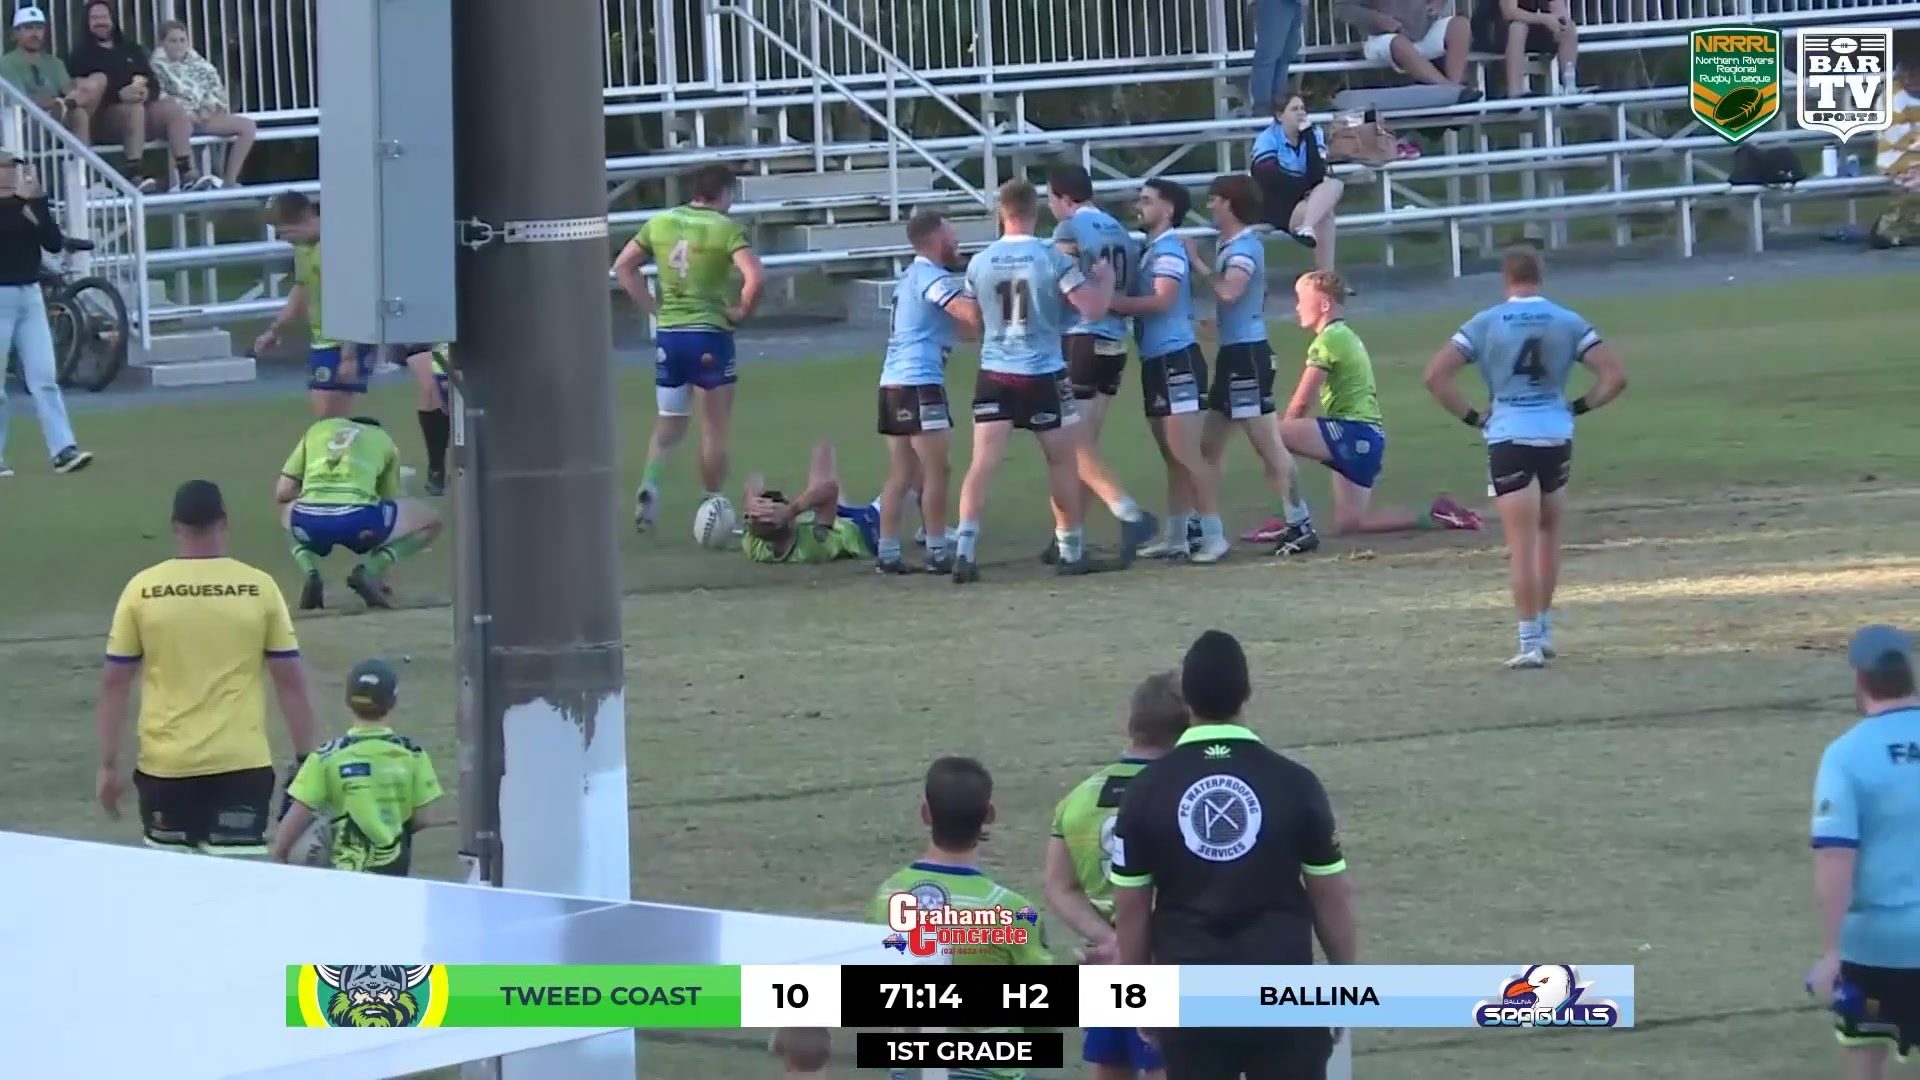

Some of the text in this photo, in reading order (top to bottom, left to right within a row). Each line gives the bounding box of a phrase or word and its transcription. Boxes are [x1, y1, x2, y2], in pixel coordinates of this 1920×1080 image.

[668, 239, 690, 278] 4
[996, 278, 1029, 324] 11
[1512, 337, 1547, 387] 4
[141, 584, 260, 599] LEAGUESAFE
[1180, 778, 1259, 818] PC WATERPROOFING
[1197, 841, 1247, 858] SERVICES
